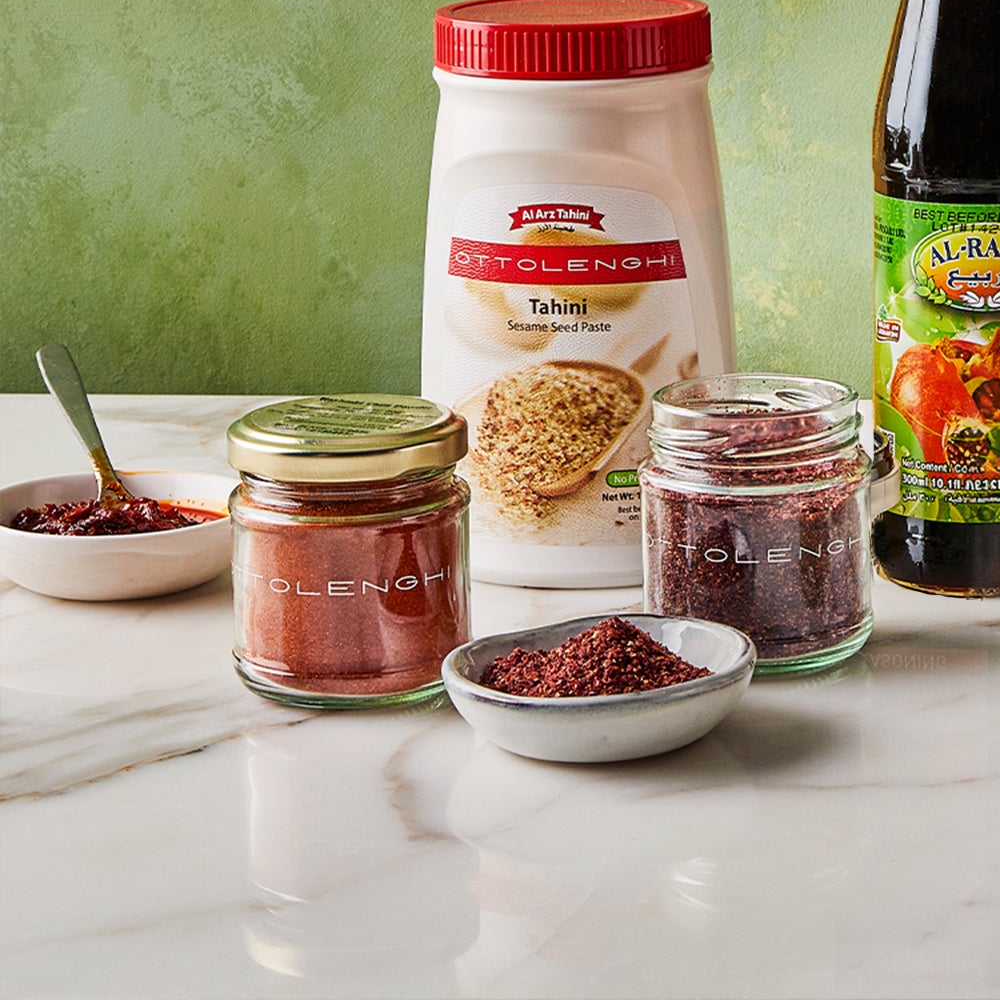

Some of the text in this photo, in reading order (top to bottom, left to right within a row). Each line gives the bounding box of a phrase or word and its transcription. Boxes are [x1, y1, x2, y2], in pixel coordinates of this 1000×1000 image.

[522, 208, 590, 221] Al Arz Tahini
[914, 208, 944, 220] BEST
[455, 251, 675, 272] OTTOLENGHI
[529, 298, 587, 315] Tahini
[507, 319, 612, 332] Sesame Seed Paste
[614, 475, 627, 484] No
[902, 473, 928, 487] 300ml
[602, 493, 618, 502] Net
[619, 492, 635, 501] Wt.
